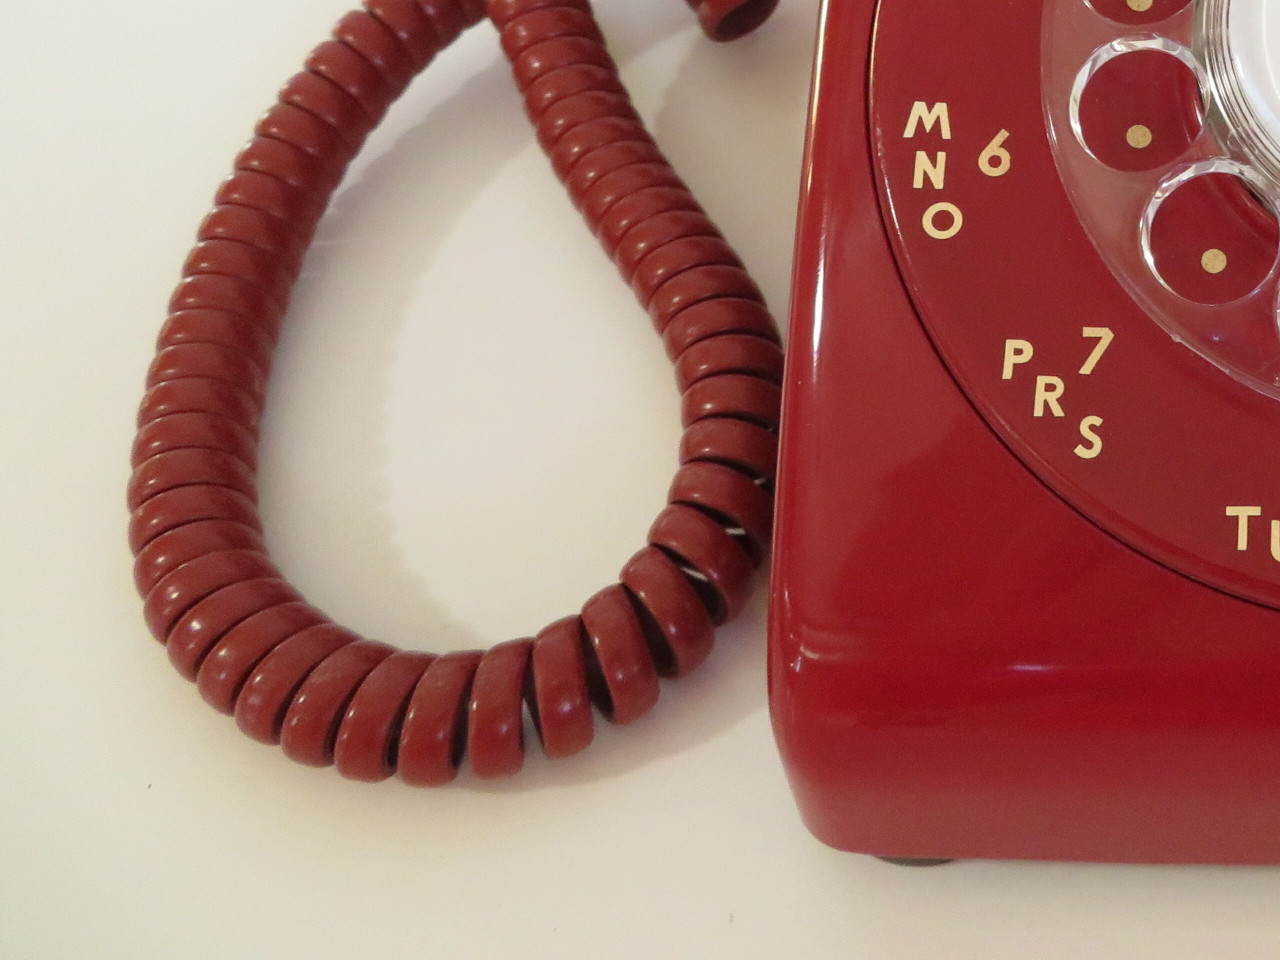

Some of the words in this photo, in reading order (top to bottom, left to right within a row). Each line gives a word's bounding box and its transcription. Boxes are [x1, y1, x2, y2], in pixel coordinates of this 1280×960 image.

[902, 100, 964, 240] MNO
[978, 128, 1011, 177] 6
[1078, 326, 1115, 375] 7
[1002, 339, 1103, 459] PRS
